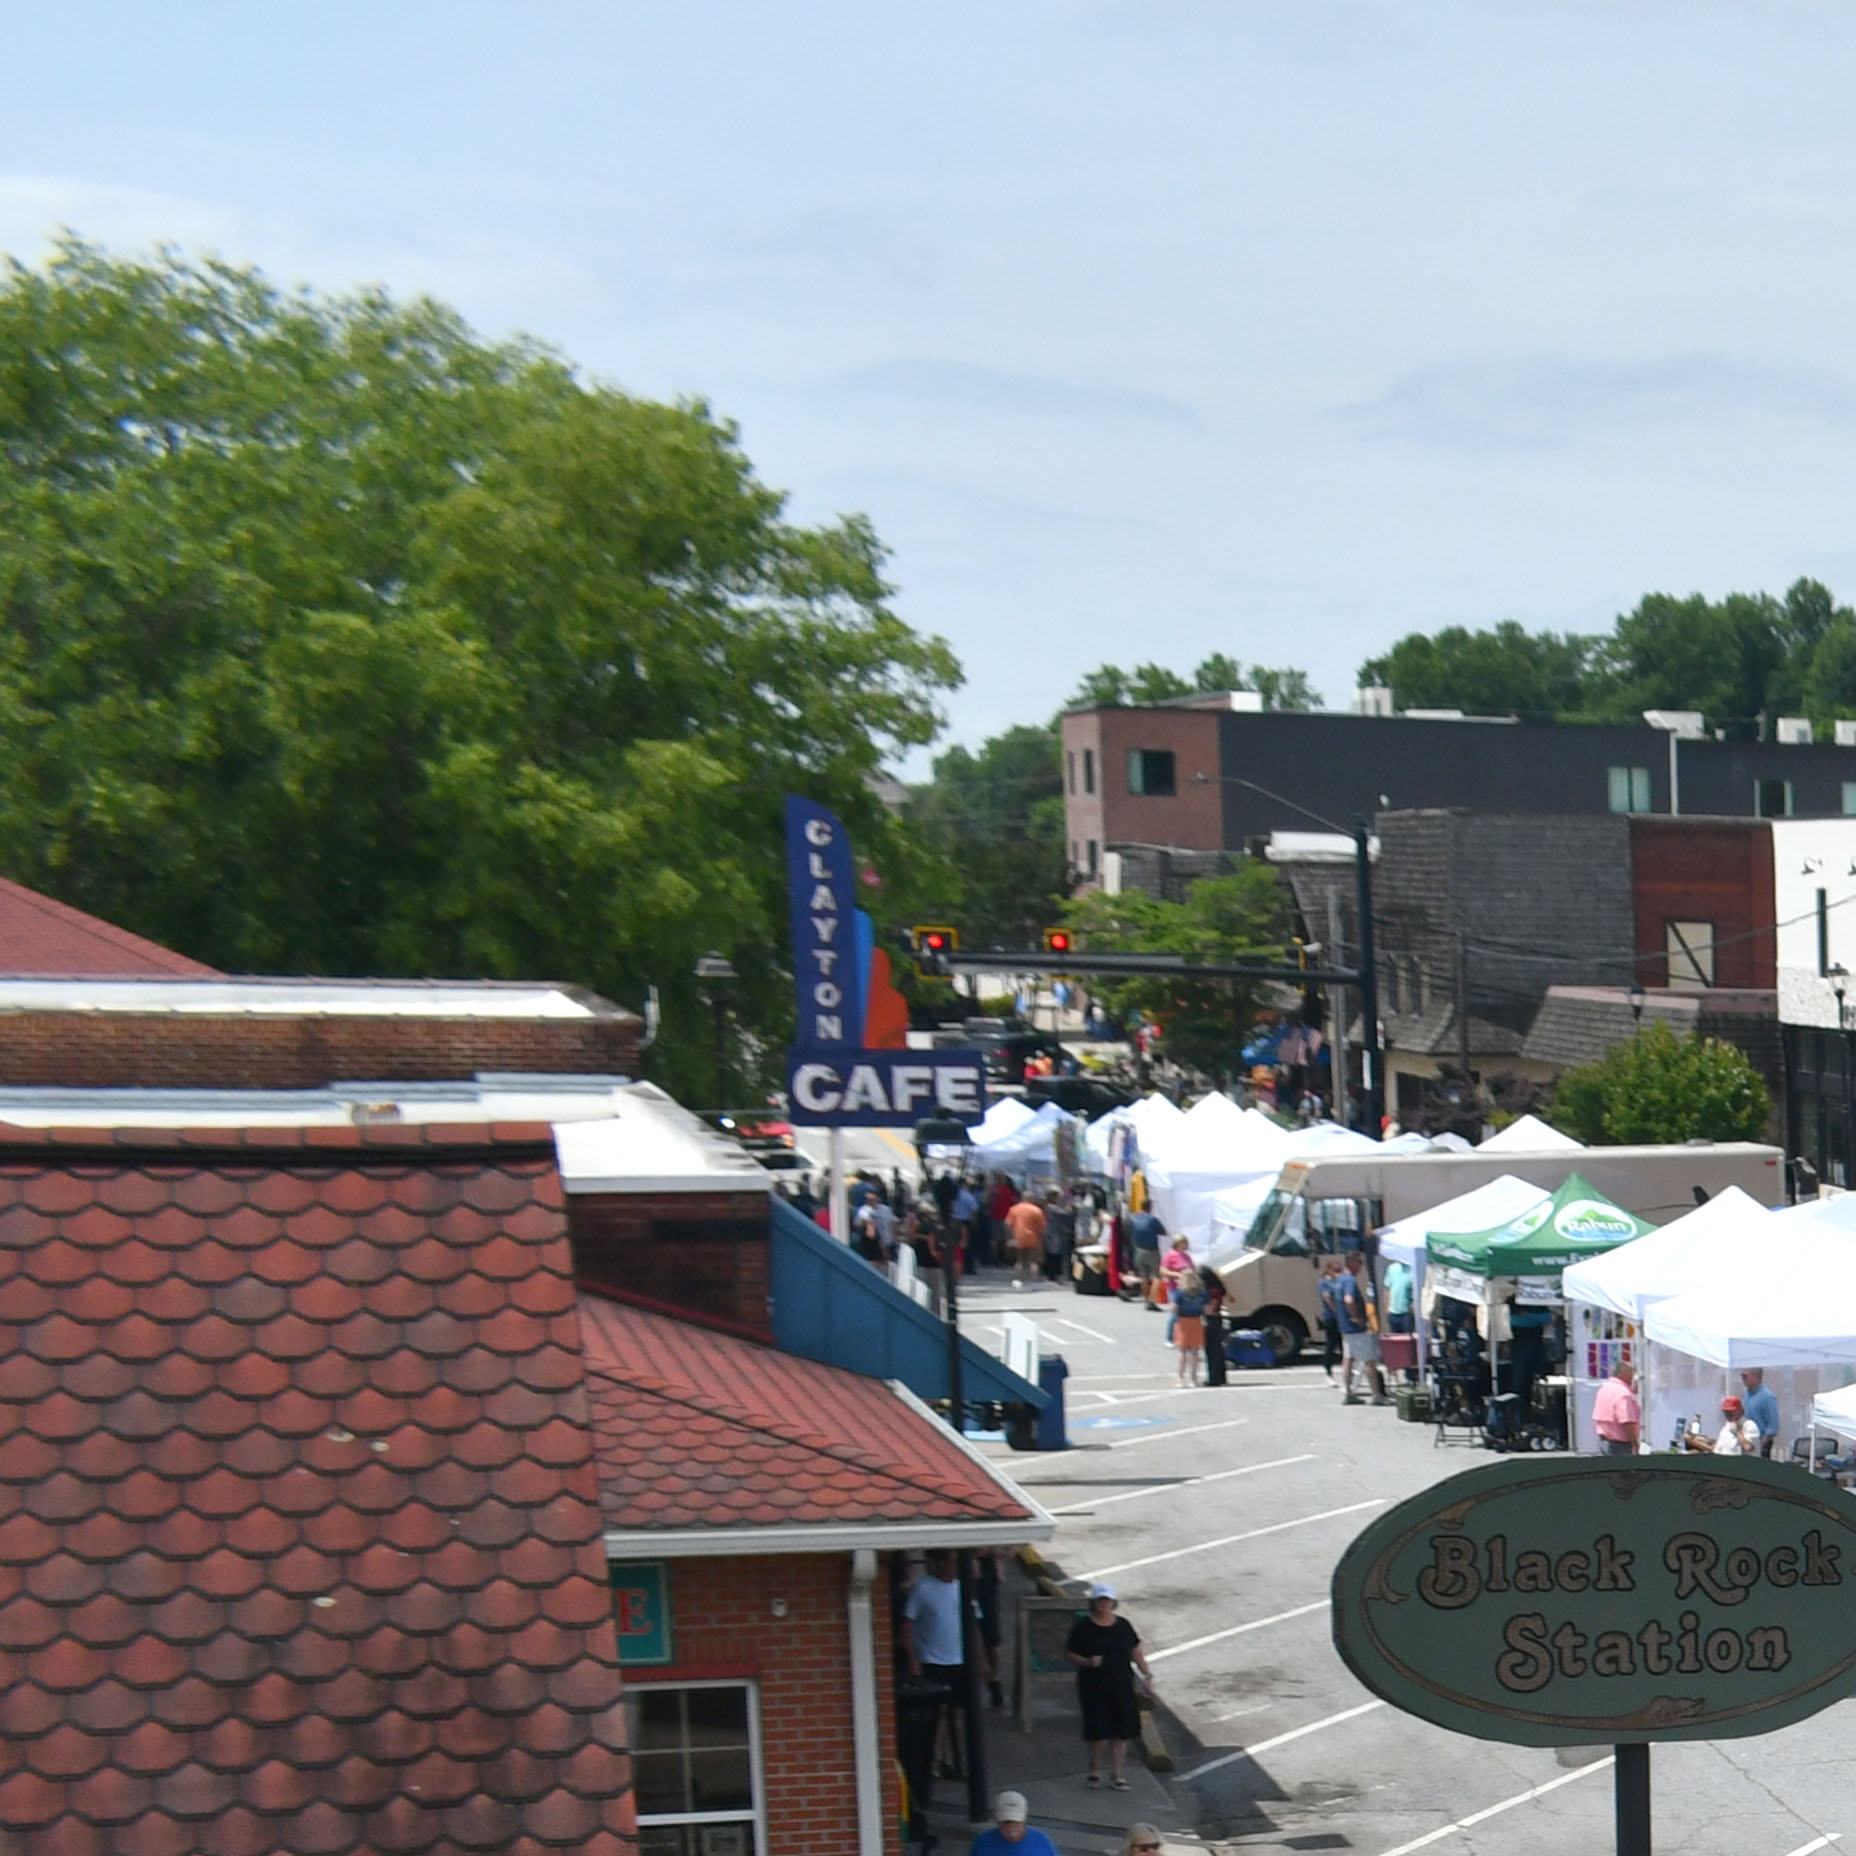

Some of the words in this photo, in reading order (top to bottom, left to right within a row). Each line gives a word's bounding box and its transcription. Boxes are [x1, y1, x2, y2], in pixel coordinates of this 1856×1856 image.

[804, 819, 842, 1040] CLAYTON
[792, 1063, 981, 1113] CAFE
[1566, 1219, 1627, 1233] Rabun
[1417, 1533, 1636, 1610] Black
[1663, 1530, 1842, 1607] Rock
[1495, 1610, 1792, 1694] Station
